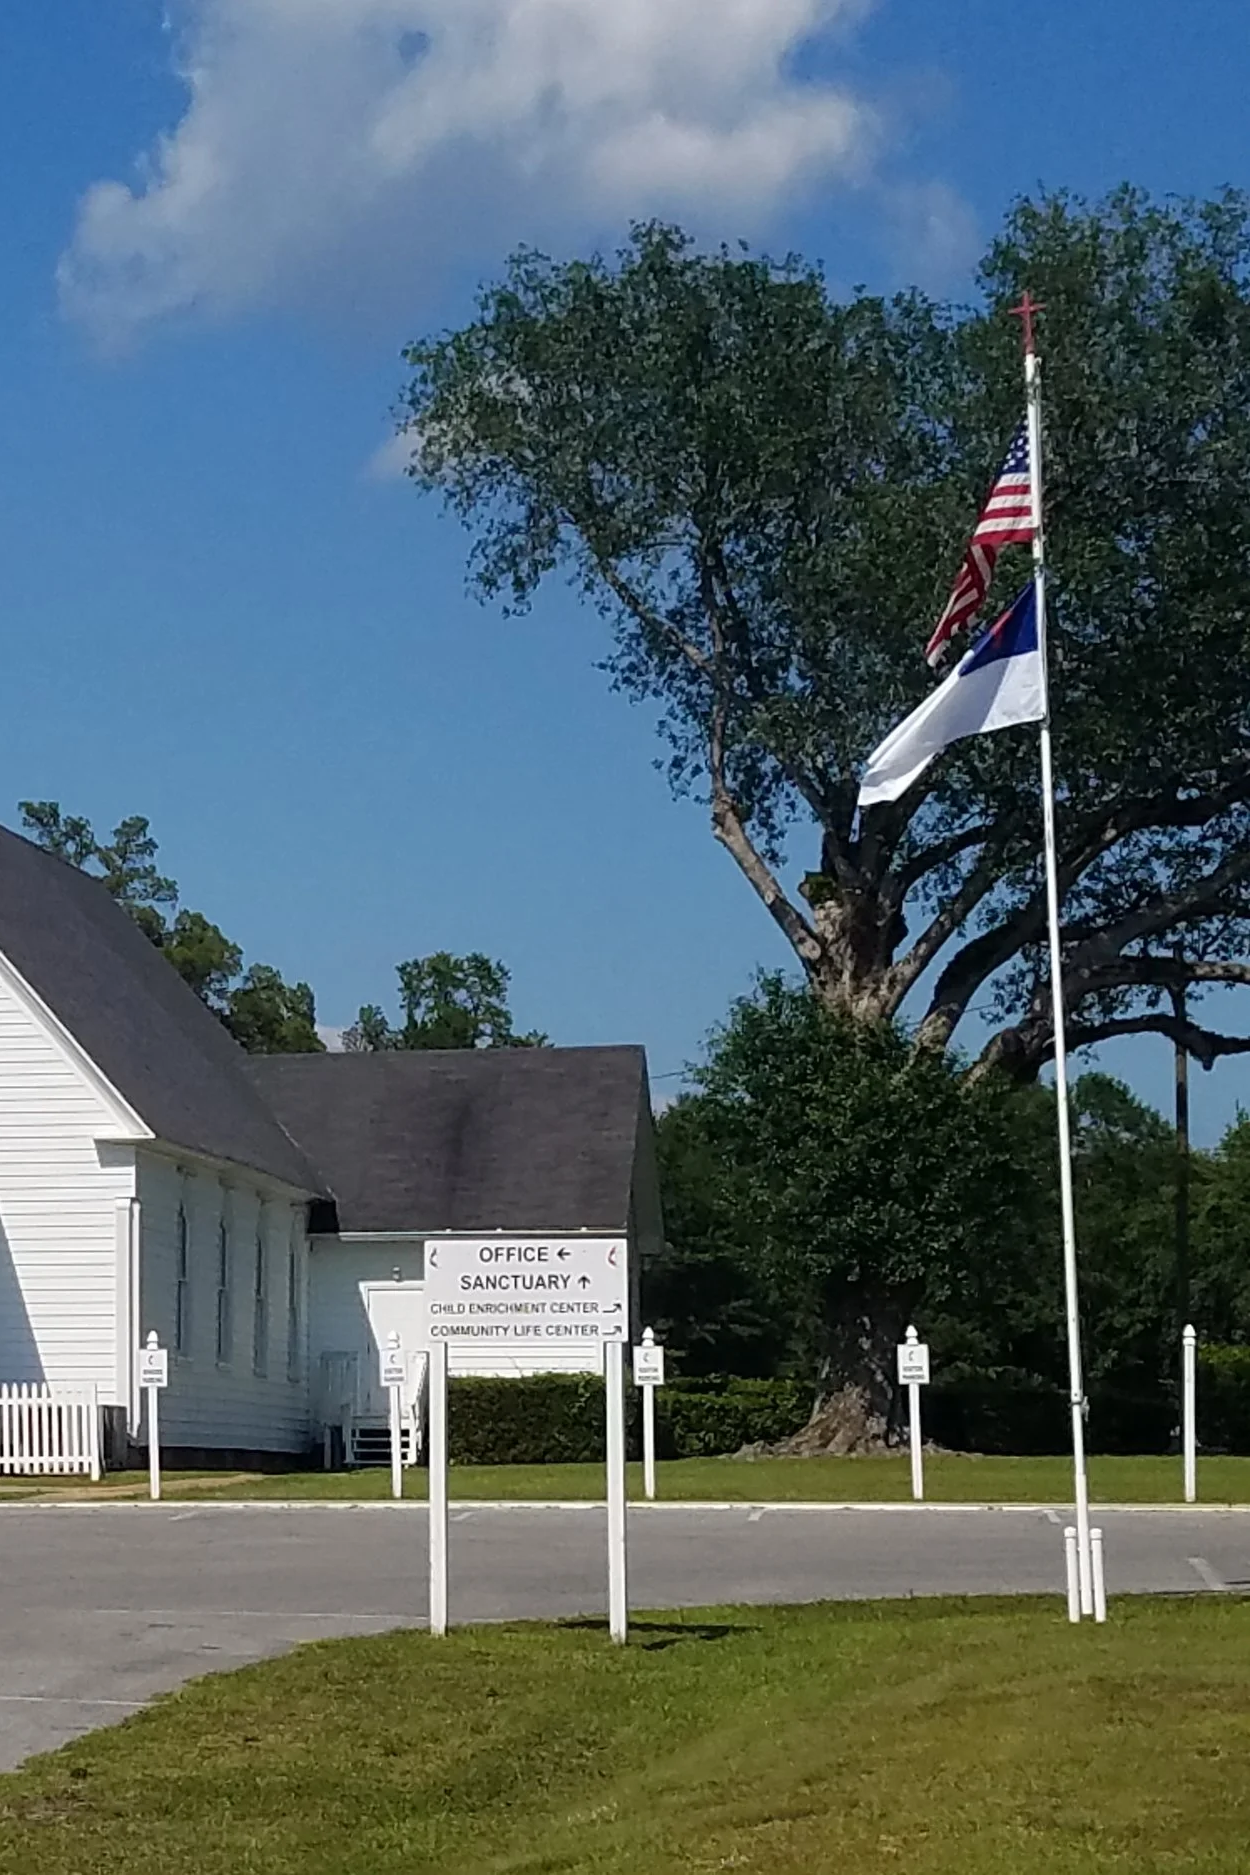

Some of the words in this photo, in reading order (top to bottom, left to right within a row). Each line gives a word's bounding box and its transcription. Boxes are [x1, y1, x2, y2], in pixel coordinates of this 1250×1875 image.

[479, 1247, 549, 1263] OFFICE
[460, 1275, 571, 1290] SANCTUARY
[430, 1303, 465, 1314] CHILD
[469, 1303, 547, 1314] ENRICHMENT
[549, 1302, 599, 1314] CENTER
[430, 1325, 510, 1337] COMMUNITY
[514, 1325, 541, 1336] LIFE
[545, 1325, 599, 1336] CENTER
